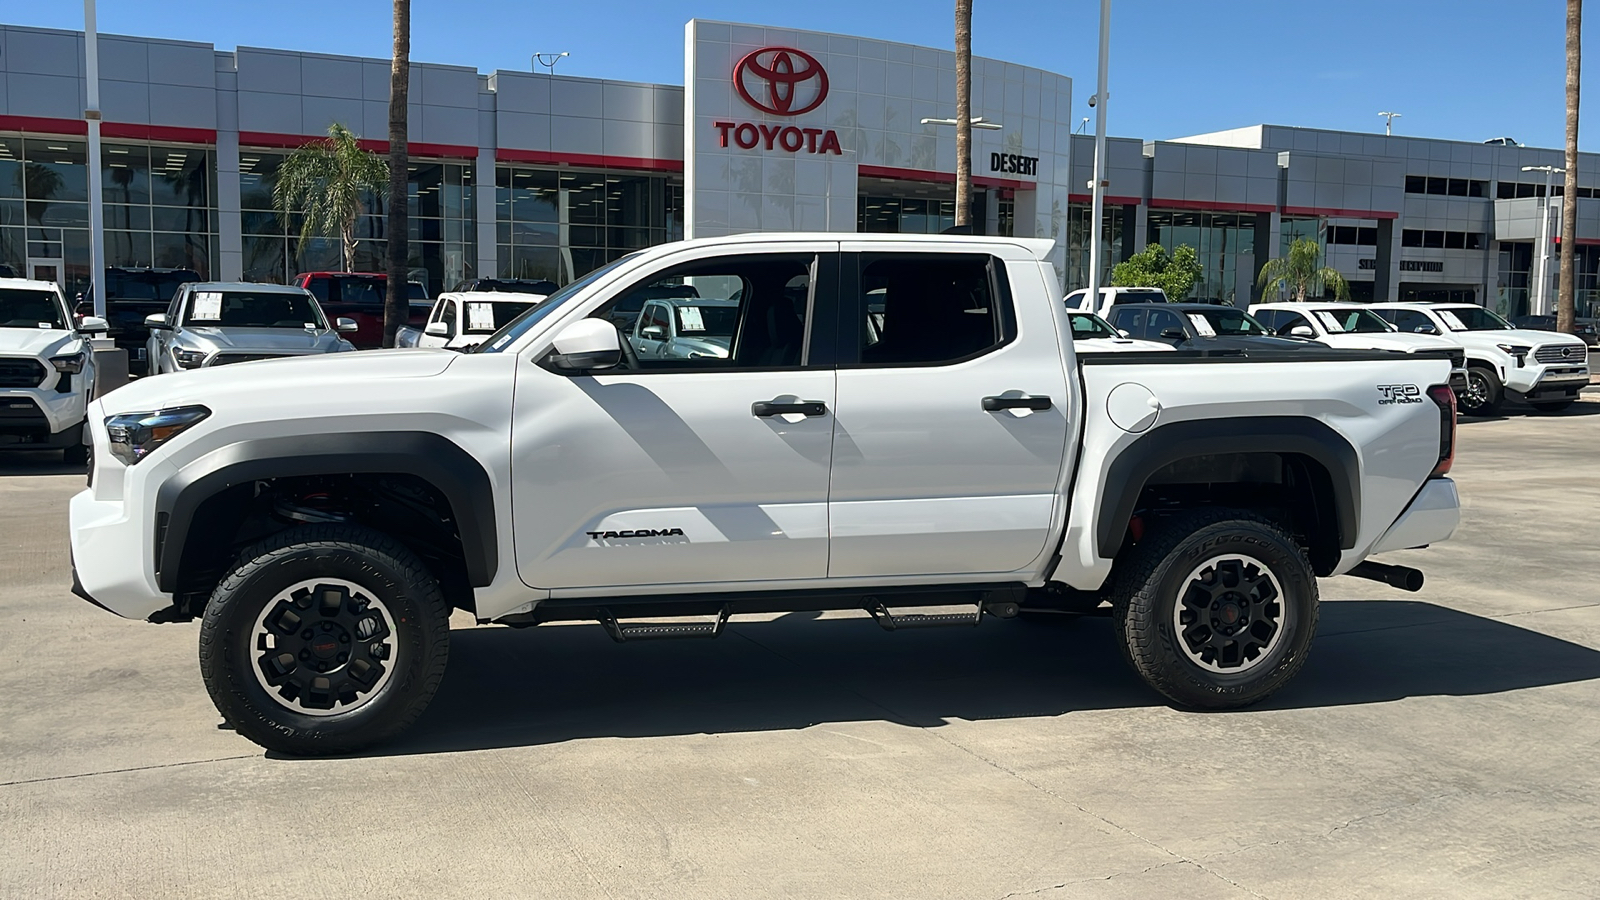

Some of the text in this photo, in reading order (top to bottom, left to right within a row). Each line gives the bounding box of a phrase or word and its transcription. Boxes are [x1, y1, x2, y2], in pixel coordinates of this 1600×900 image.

[713, 121, 842, 155] TOYOTA
[991, 152, 1039, 176] DESERT
[1376, 383, 1420, 400] TRD
[586, 528, 684, 540] TACOMA
